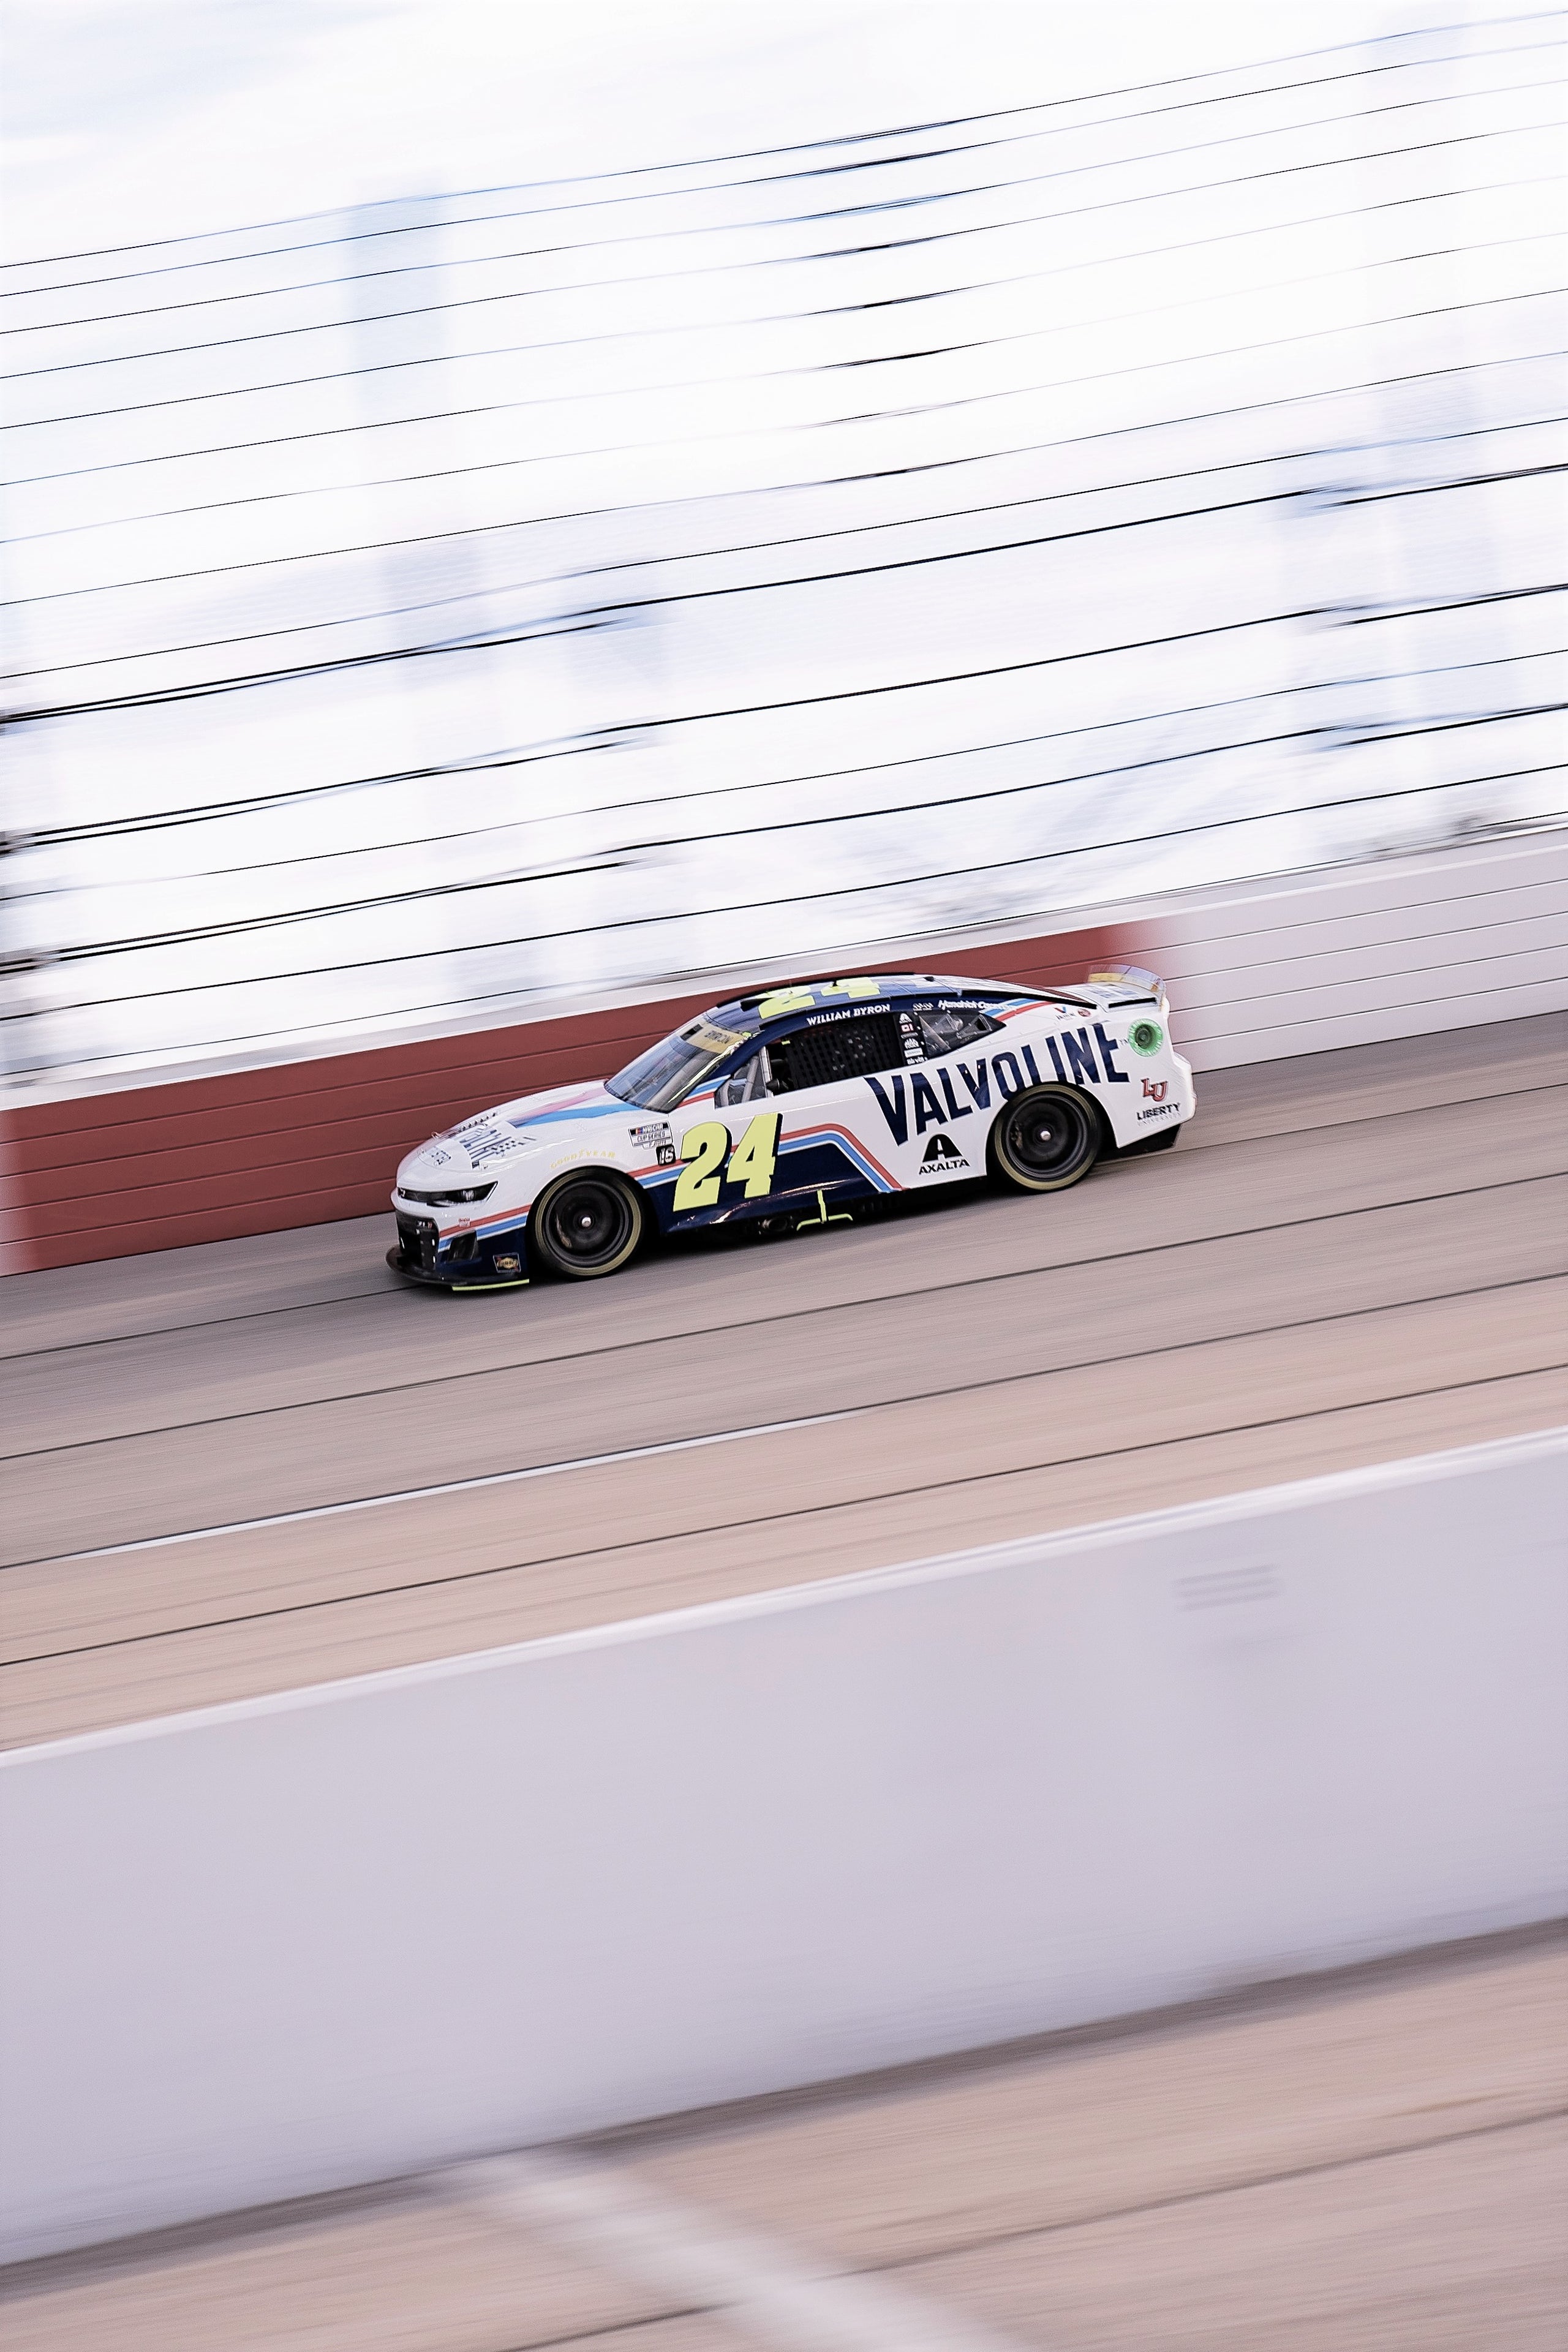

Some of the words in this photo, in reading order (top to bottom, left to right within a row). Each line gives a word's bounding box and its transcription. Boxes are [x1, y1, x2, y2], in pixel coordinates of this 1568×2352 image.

[758, 977, 880, 1019] 24
[806, 1009, 851, 1026] WILLIAM
[865, 1022, 1129, 1146] VALVOLINE
[1140, 1078, 1168, 1102] LU
[1136, 1102, 1180, 1120] LIBERTY
[643, 1123, 663, 1134] NASCAR
[648, 1130, 666, 1140] SERIES
[673, 1112, 782, 1212] 24
[919, 1158, 971, 1175] AXALTA
